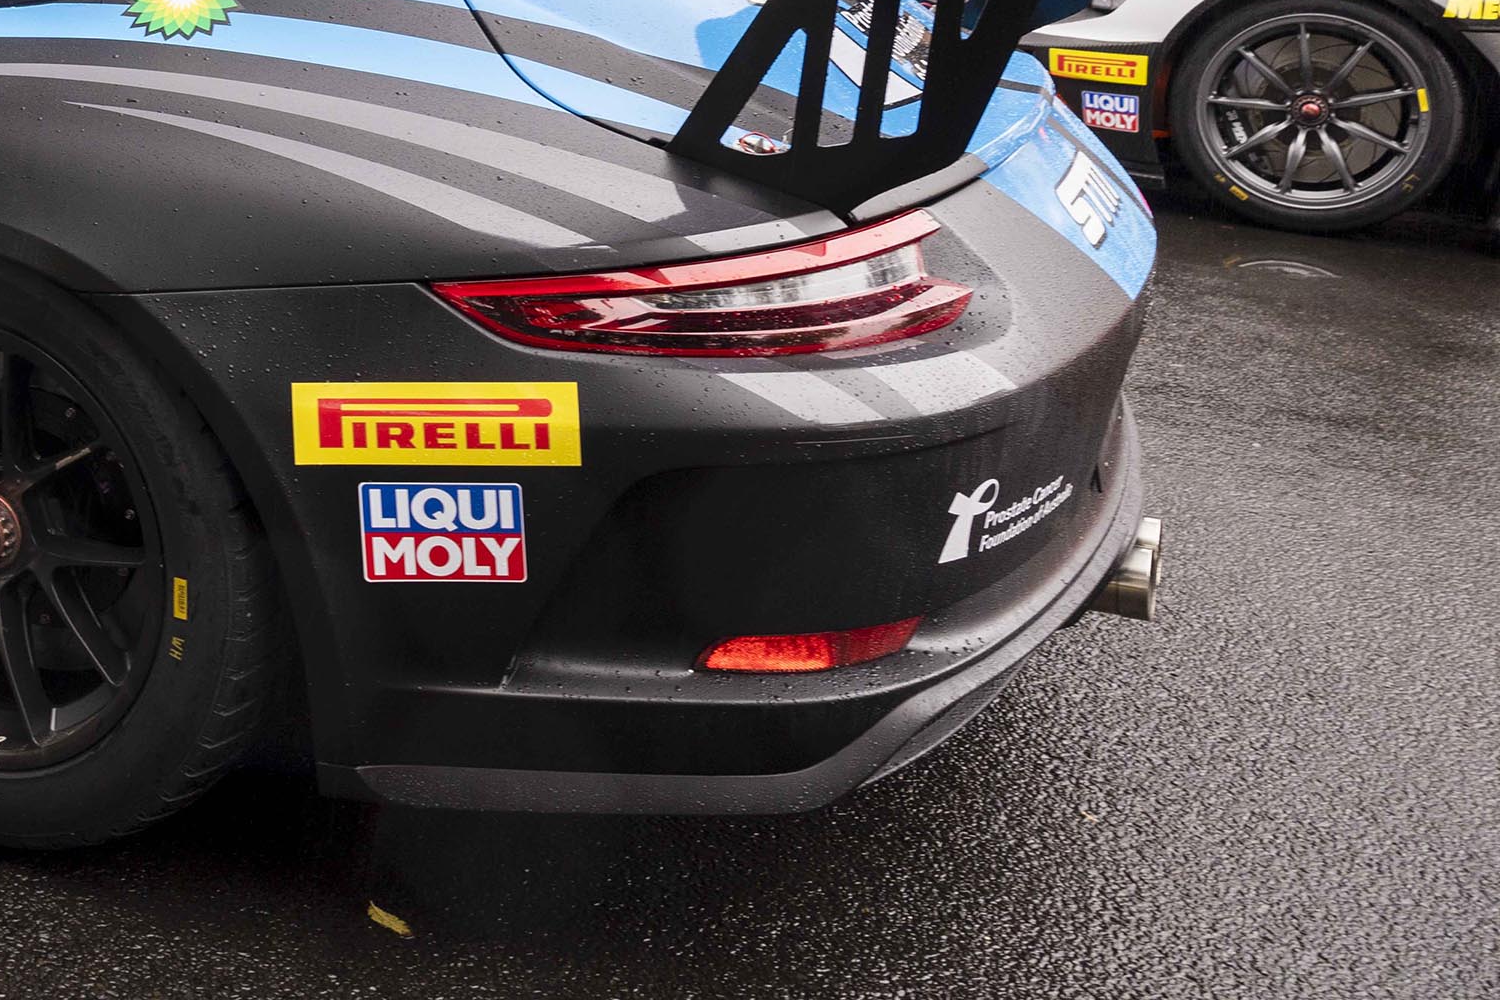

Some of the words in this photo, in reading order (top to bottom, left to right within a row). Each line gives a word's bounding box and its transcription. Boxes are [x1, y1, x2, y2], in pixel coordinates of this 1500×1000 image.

[1057, 55, 1137, 79] PIRELLI
[1085, 93, 1136, 113] LIQUI
[1086, 109, 1136, 130] MOLY
[318, 398, 553, 450] PIRELLI
[368, 487, 515, 532] LIQUI
[983, 497, 1033, 529] Prostate
[979, 515, 1034, 552] Foundation
[371, 535, 521, 577] MOLY
